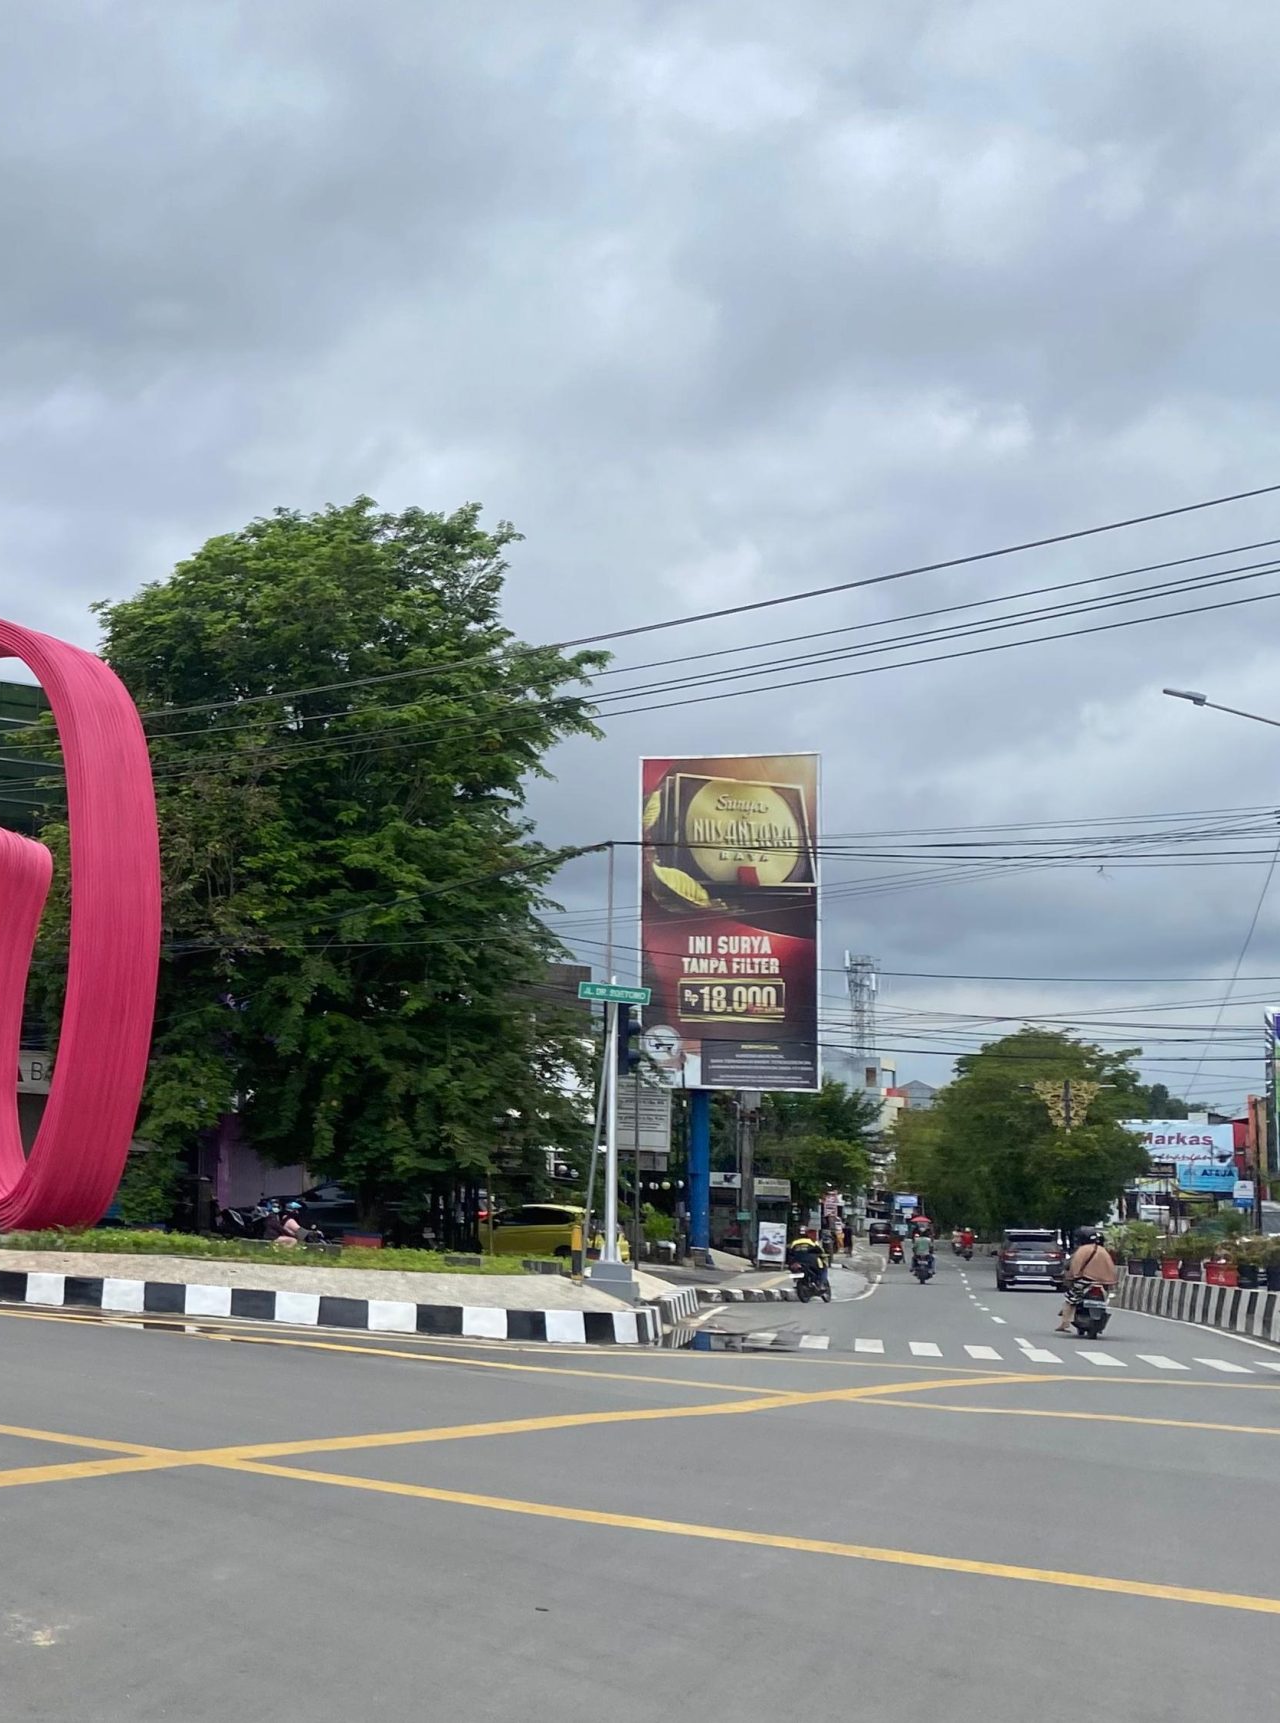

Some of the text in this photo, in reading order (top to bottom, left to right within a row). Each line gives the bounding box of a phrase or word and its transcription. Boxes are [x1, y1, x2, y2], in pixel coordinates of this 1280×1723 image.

[693, 817, 793, 848] NUSANTARA
[688, 935, 773, 955] INI SURYA
[681, 957, 780, 974] TANPA FILTER
